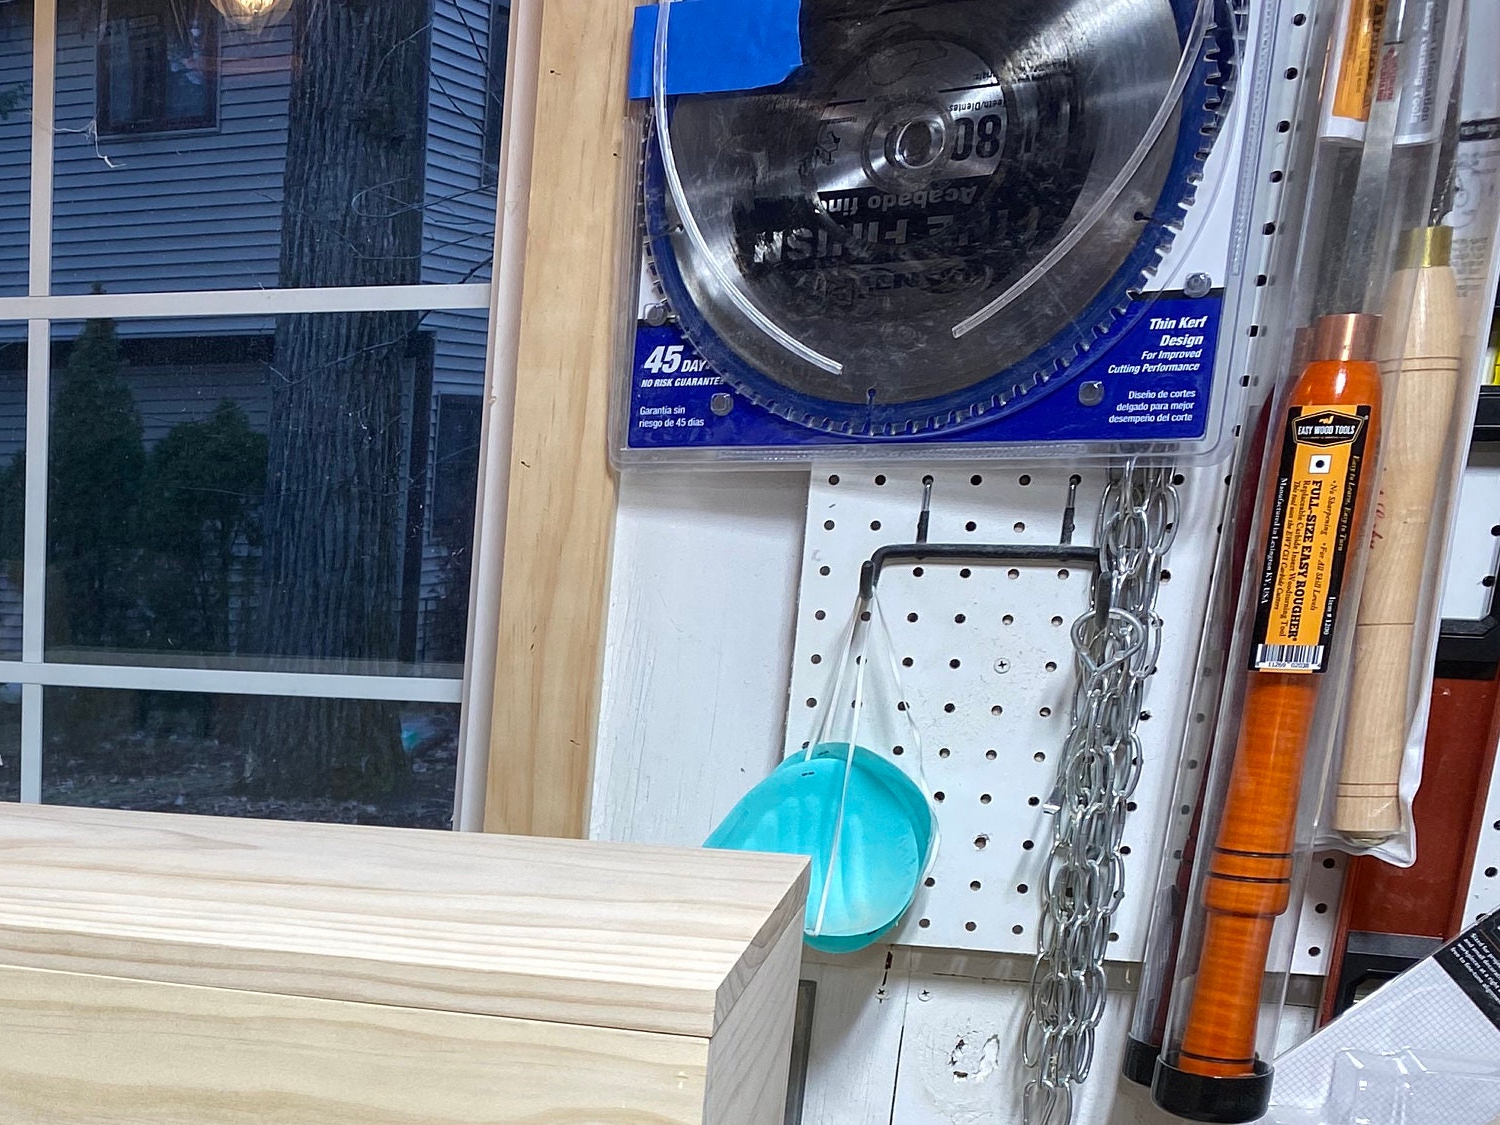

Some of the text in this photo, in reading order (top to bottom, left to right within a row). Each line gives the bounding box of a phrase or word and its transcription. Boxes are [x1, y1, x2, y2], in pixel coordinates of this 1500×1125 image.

[951, 114, 1001, 161] 80
[868, 186, 978, 211] Acabado
[1149, 315, 1208, 330] Thin Kerf
[1159, 334, 1204, 348] Design
[643, 345, 684, 373] 45
[1141, 349, 1202, 361] For Improved
[1108, 362, 1200, 375] Cutting Performance
[641, 379, 653, 387] NO
[654, 378, 672, 387] RISK
[1129, 390, 1196, 400] Diseño de cortes
[673, 404, 685, 414] sin
[1116, 401, 1195, 412] delgado para mejor
[639, 419, 662, 429] riesgo
[664, 418, 674, 427] de
[676, 417, 686, 426] 45
[1109, 413, 1193, 424] desempeño del corte
[1298, 425, 1356, 435] EASY WOOD TOOLS
[1350, 456, 1359, 471] Easy
[1273, 478, 1288, 526] Manufactured
[1320, 485, 1337, 534] No Sharpening
[1303, 481, 1323, 542] FULL-SIZE
[1341, 508, 1351, 523] Easy
[1338, 534, 1346, 550] Turn
[1279, 481, 1311, 636] Replaceable Carbide Insert Woodturning Tool
[1298, 546, 1312, 576] EASY
[1317, 561, 1325, 570] All
[1278, 563, 1288, 585] Carbide
[1315, 574, 1323, 587] Skill
[1261, 588, 1270, 603] USA
[1311, 591, 1320, 610] Levels
[1327, 597, 1336, 611] Item
[1464, 937, 1473, 947] and
[1472, 947, 1485, 960] small
[1471, 933, 1484, 946] Sized
[1482, 945, 1490, 954] for
[1451, 947, 1460, 957] free
[1464, 962, 1484, 983] fine-tune
[1457, 943, 1481, 968] workpieces
[1487, 976, 1500, 989] right
